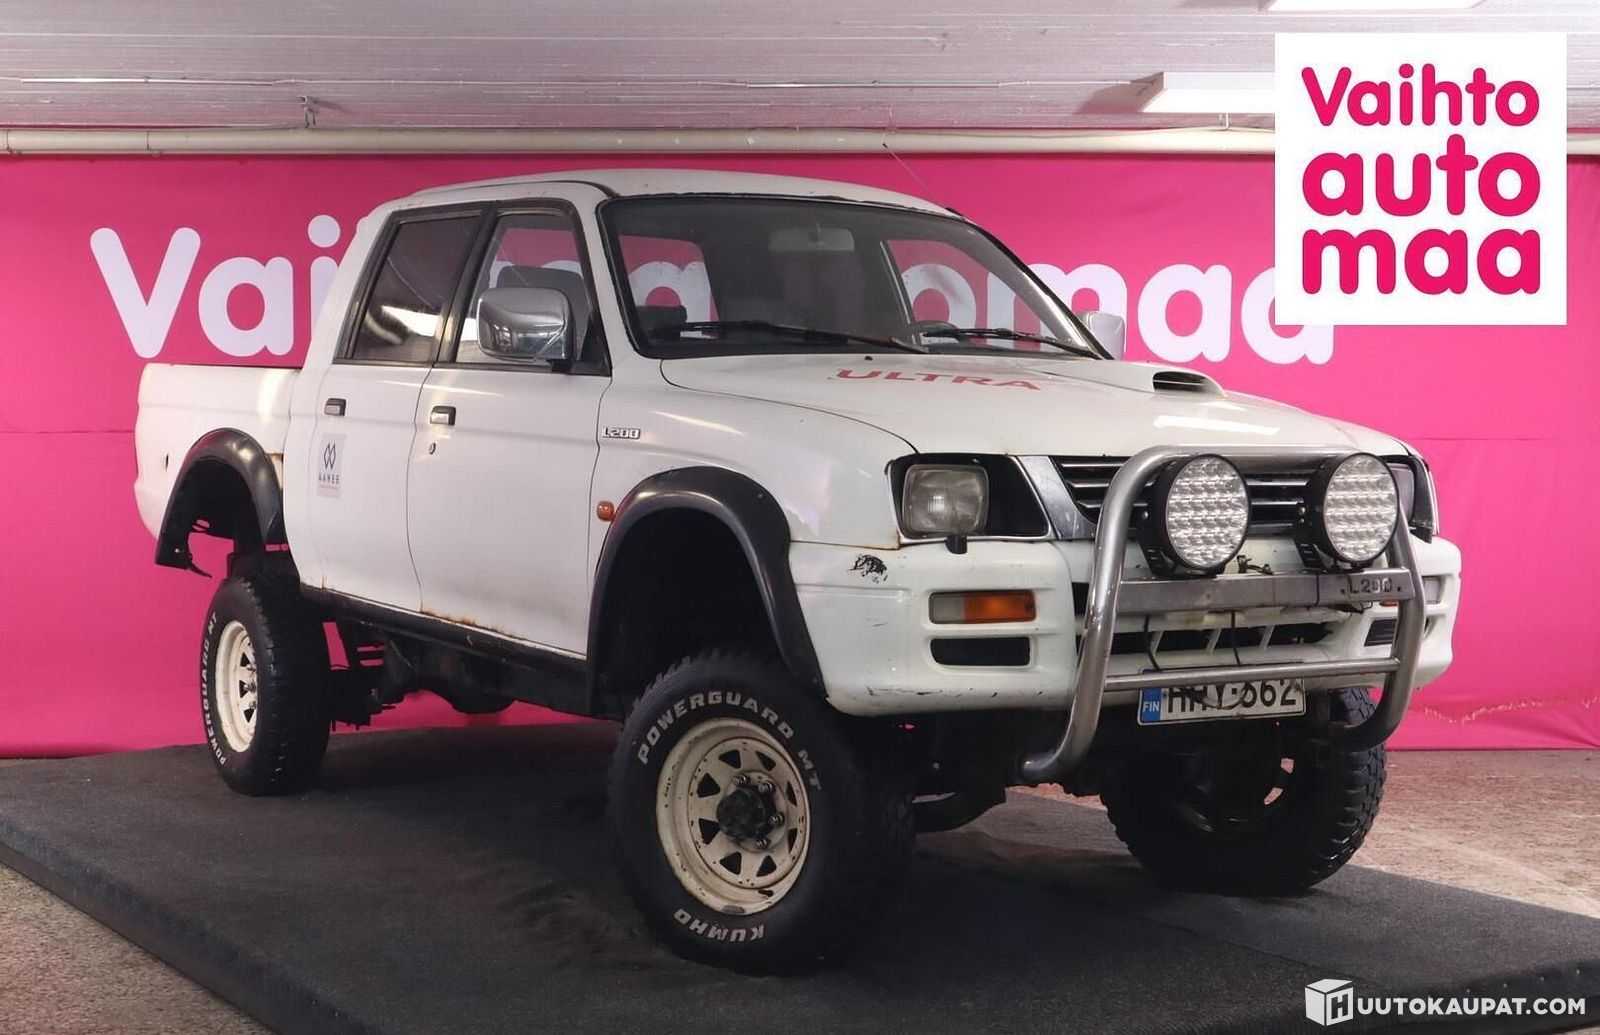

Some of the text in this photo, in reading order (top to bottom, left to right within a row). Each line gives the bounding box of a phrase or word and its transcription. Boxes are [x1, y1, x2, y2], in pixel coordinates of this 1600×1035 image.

[836, 368, 1042, 391] ULTRA
[602, 427, 641, 440] L200
[1143, 700, 1160, 713] FIN
[637, 691, 822, 791] POWERGUARD MT
[673, 908, 765, 943] KUMHO
